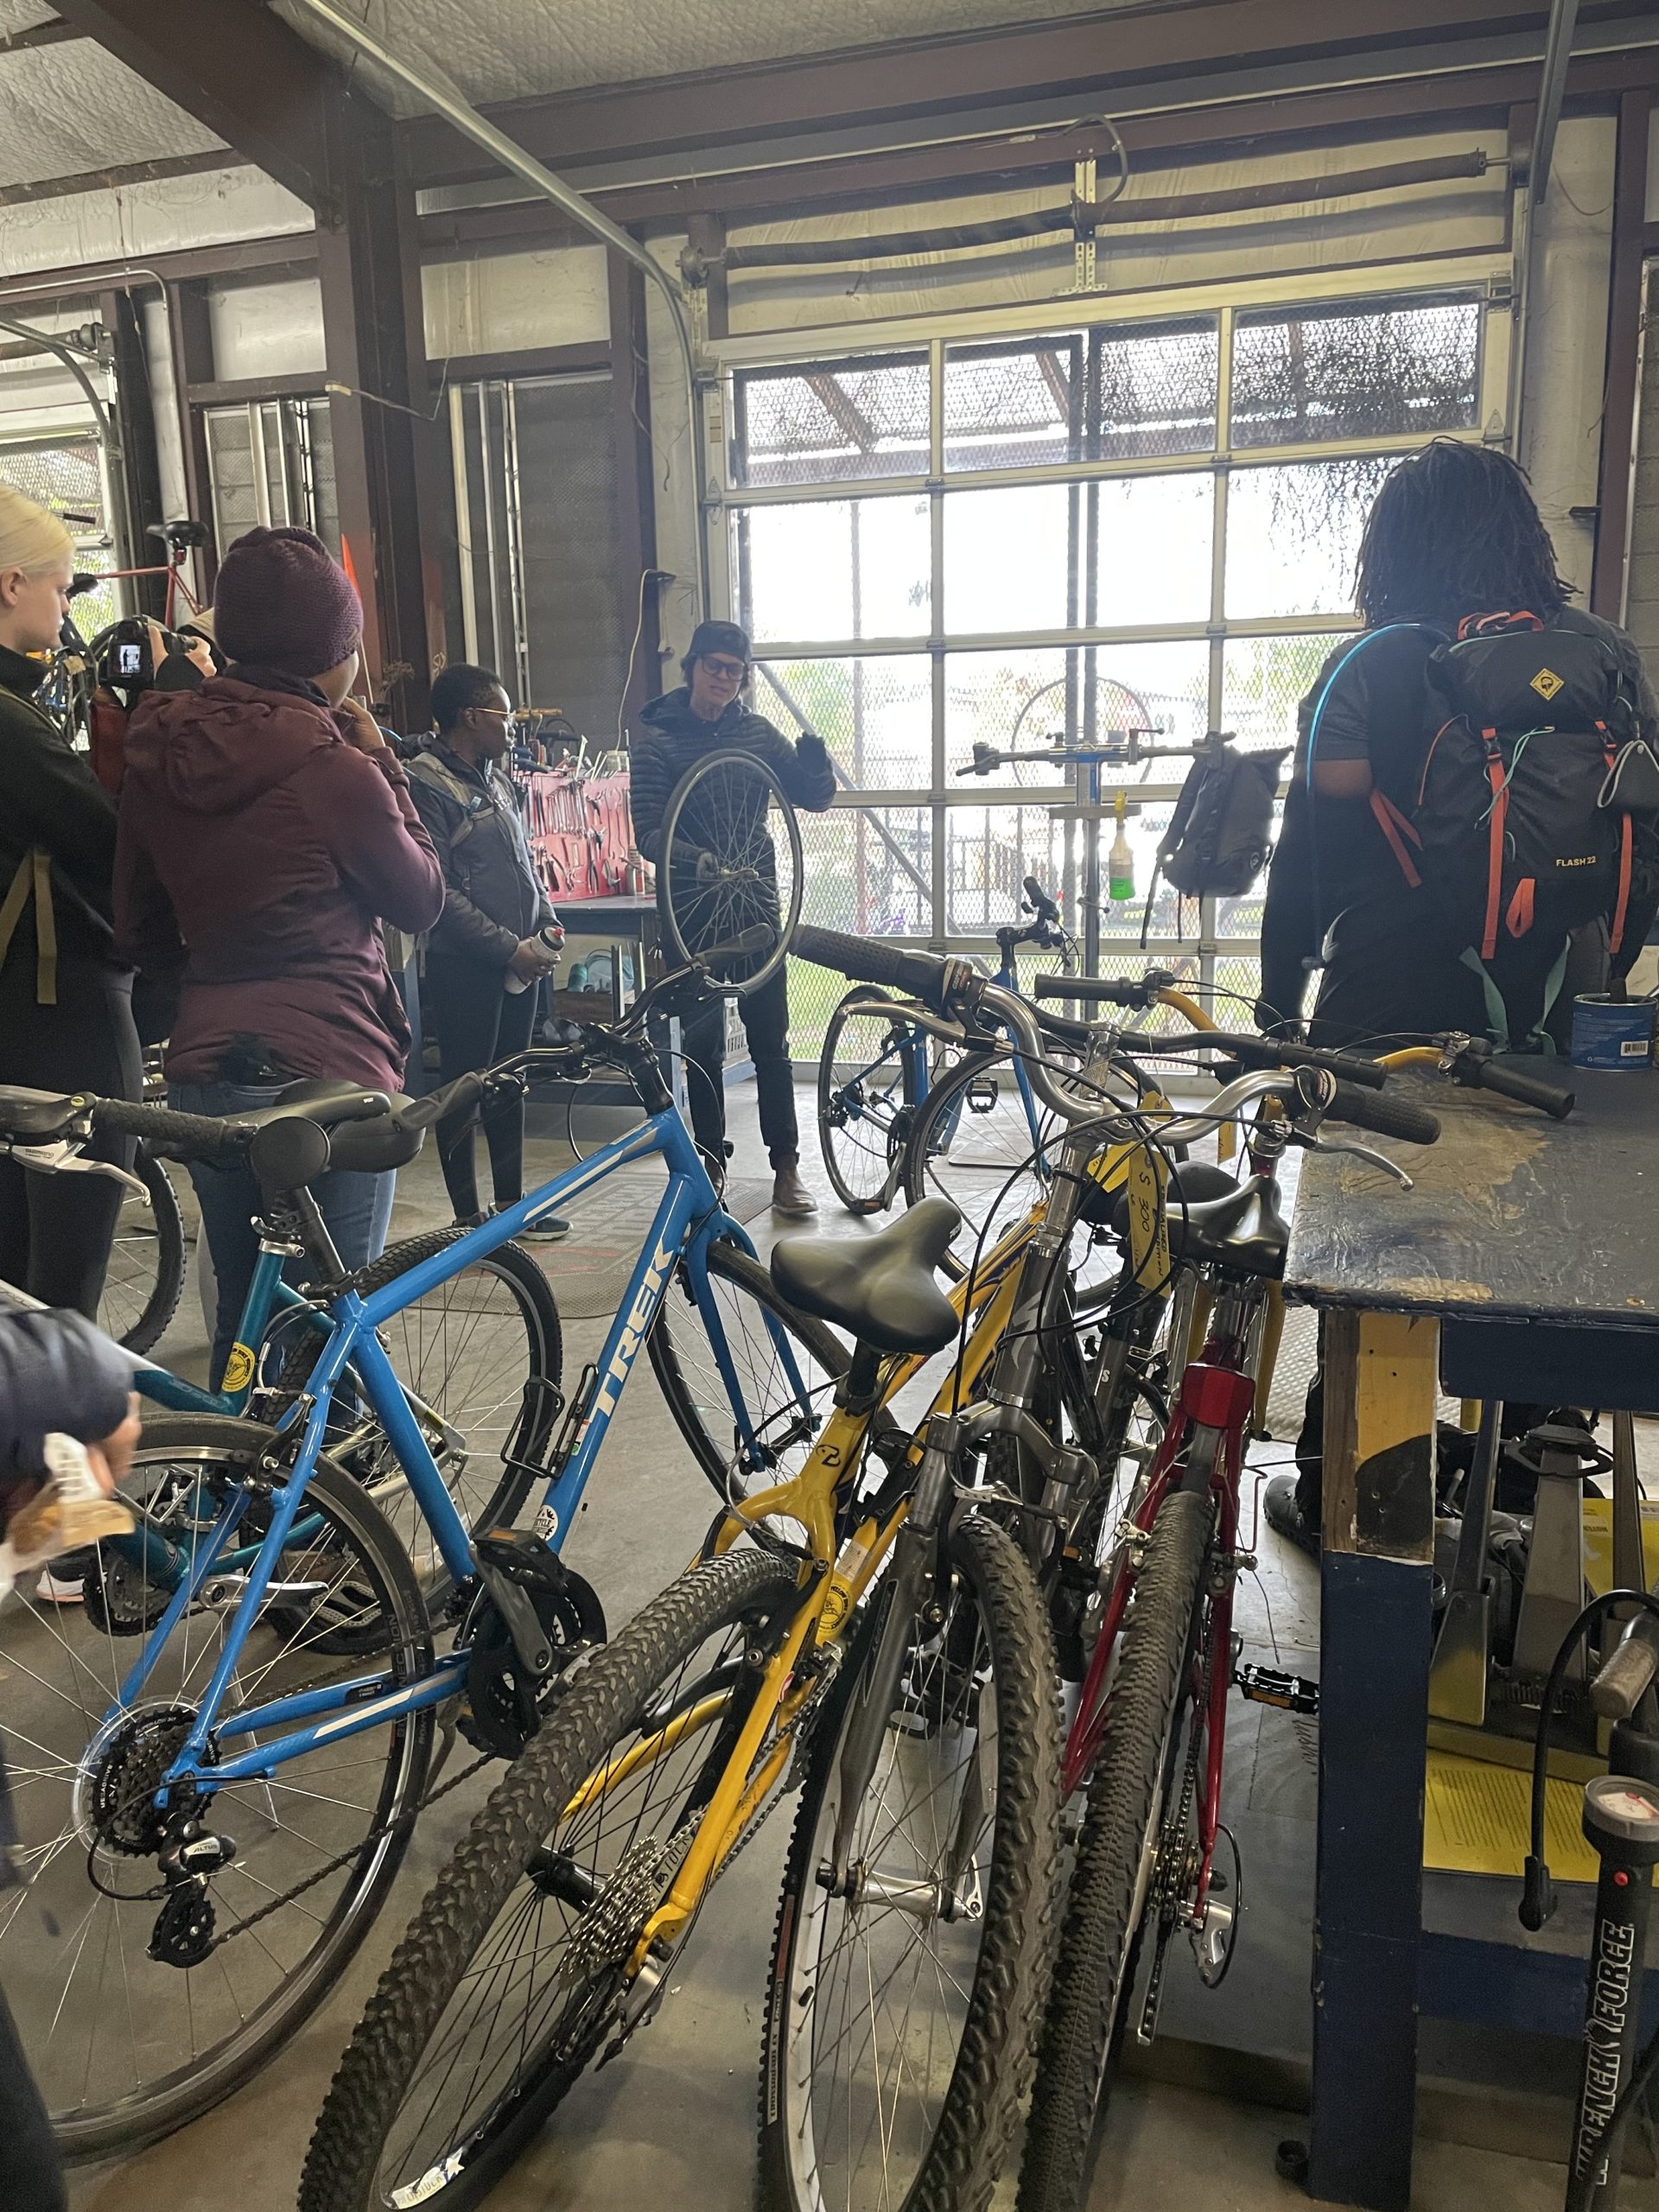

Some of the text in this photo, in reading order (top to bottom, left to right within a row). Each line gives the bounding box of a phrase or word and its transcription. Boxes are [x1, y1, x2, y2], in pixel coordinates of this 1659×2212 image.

[1555, 855, 1597, 867] FLASH 22
[1138, 1197, 1150, 1232] 300
[589, 1240, 674, 1423] TREK
[194, 1844, 218, 1853] ALTUS
[1593, 1918, 1635, 2027] FORCE
